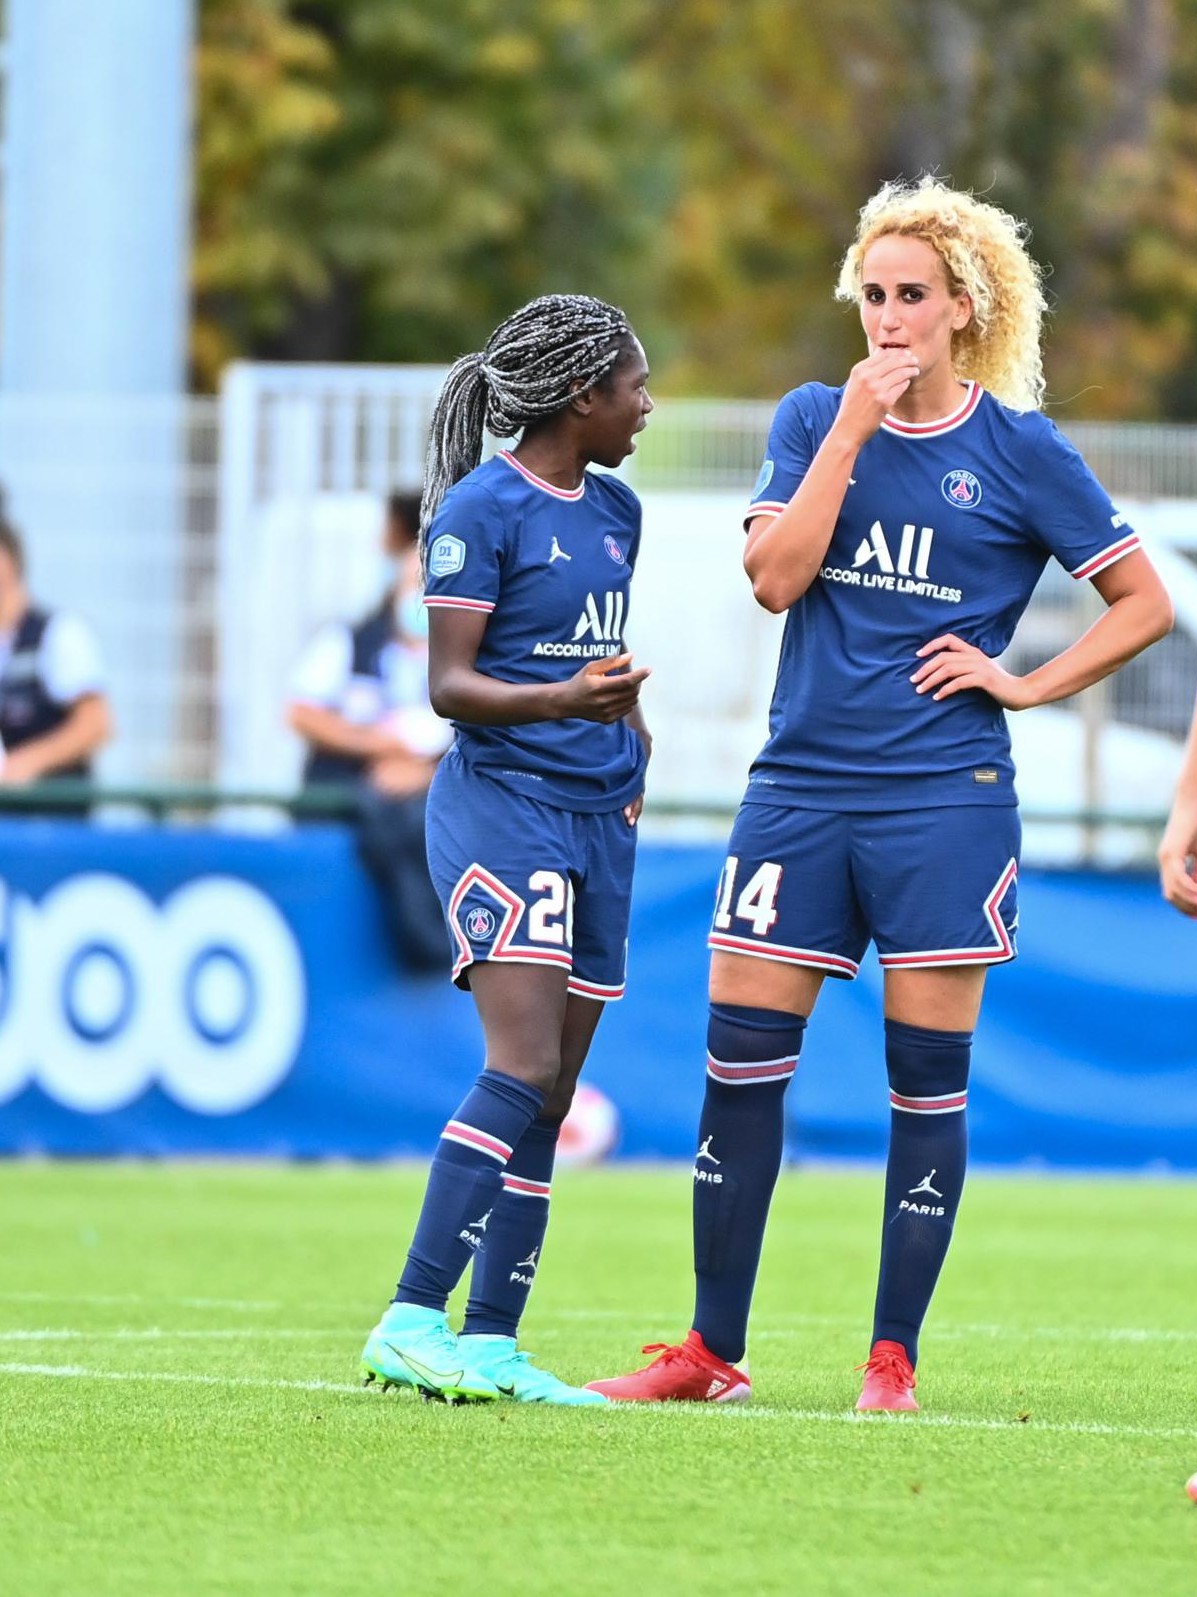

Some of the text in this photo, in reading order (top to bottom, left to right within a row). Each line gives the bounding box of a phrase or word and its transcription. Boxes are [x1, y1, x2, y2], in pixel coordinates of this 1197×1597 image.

[438, 545, 452, 557] D1
[819, 567, 962, 603] ACCOR LIVE LIMITLESS
[532, 642, 582, 657] ACCOR
[583, 644, 605, 657] LIVE
[715, 855, 782, 936] 14
[899, 1200, 945, 1216] PARIS
[459, 1230, 484, 1247] PAR
